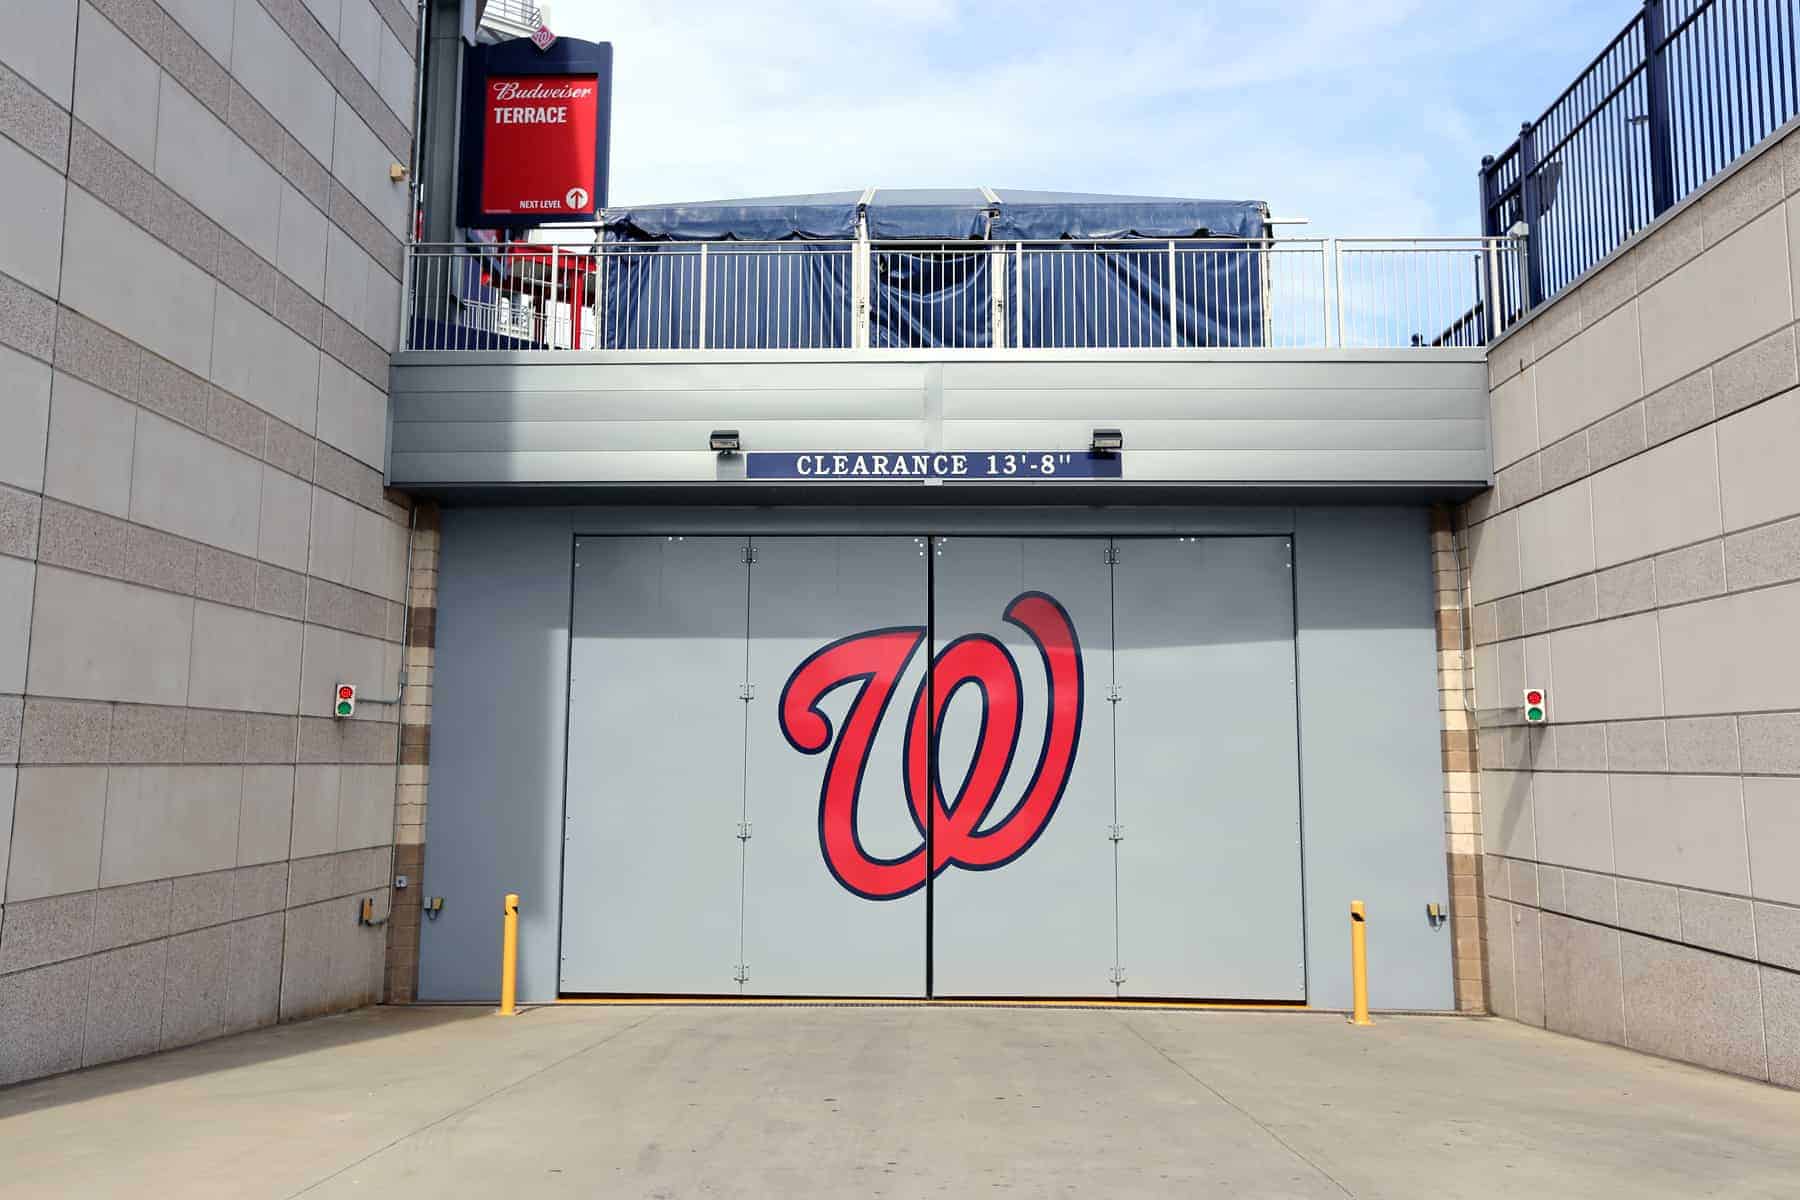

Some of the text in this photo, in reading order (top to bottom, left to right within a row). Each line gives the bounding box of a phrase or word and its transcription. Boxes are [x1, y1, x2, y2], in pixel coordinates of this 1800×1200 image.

[493, 82, 592, 100] Budweiser
[494, 106, 568, 124] TERRACE
[519, 200, 562, 209] NEXT LEVEL
[796, 453, 1072, 475] CLEARANCE 13'-8"
[778, 590, 1085, 901] W
